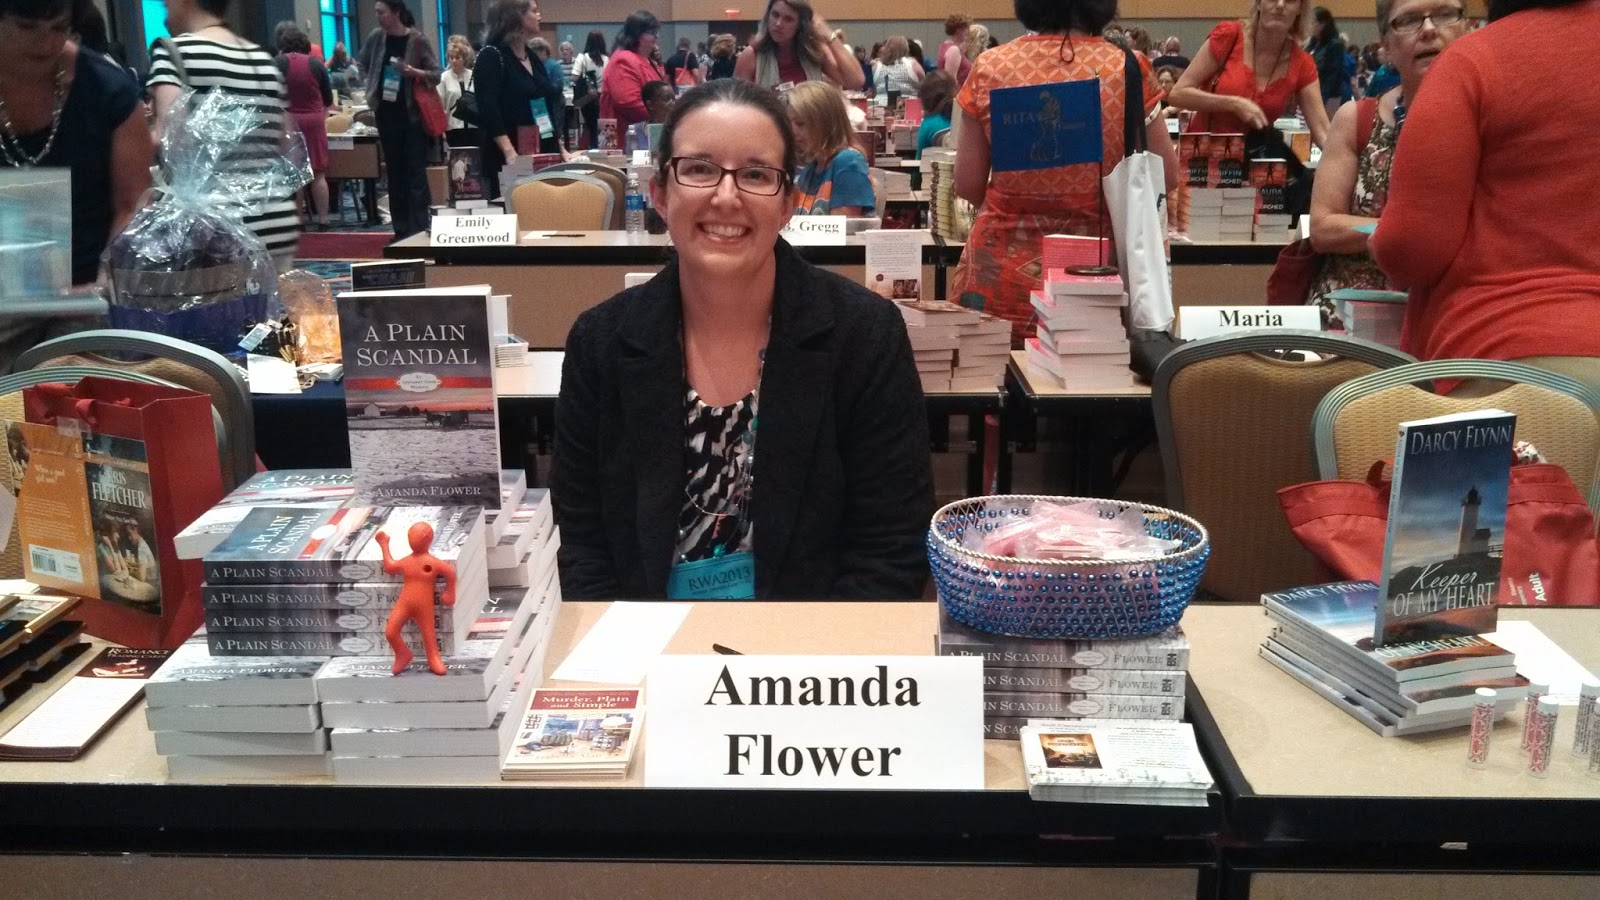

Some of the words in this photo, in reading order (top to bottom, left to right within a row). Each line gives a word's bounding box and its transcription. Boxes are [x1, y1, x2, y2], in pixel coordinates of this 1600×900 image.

[455, 216, 493, 230] Emily
[799, 220, 840, 234] Gregg
[436, 232, 510, 245] Greenwood
[1219, 309, 1284, 327] Maria
[364, 325, 381, 342] A
[386, 323, 467, 342] PLAIN
[356, 347, 477, 367] SCANDAL
[1410, 429, 1462, 455] DARCY
[1465, 424, 1512, 449] FLYNN
[245, 479, 354, 490] SCANDAL
[283, 474, 354, 482] PLAIN
[91, 481, 147, 510] FLETCHER
[375, 487, 427, 498] AMANDA
[430, 485, 481, 497] FLOWER
[252, 515, 294, 545] PLAIN
[268, 512, 321, 554] SCANDAL
[211, 568, 221, 578] A
[223, 566, 266, 578] PLAIN
[268, 566, 334, 578] SCANDAL
[688, 565, 751, 591] RWA2013
[1409, 563, 1478, 595] Keeper
[1273, 587, 1329, 603] DARCY
[1327, 582, 1379, 594] FLYNN
[1528, 572, 1547, 602] Adult
[210, 594, 219, 604] A
[221, 592, 264, 604] PLAIN
[266, 592, 331, 604] SCANDAL
[1393, 591, 1414, 617] OF
[1417, 587, 1444, 615] MY
[1446, 582, 1495, 611] HEART
[211, 617, 221, 627] A
[224, 616, 265, 628] PLAIN
[267, 616, 331, 628] SCANDAL
[215, 641, 225, 650] A
[227, 639, 268, 651] PLAIN
[270, 639, 334, 650] SCANDAL
[1430, 635, 1484, 651] HEART
[1004, 650, 1068, 663] SCANDAL
[1114, 654, 1164, 664] FLOWER
[704, 663, 921, 707] Amanda
[999, 674, 1063, 687] SCANDAL
[1109, 679, 1158, 689] FLOWER
[542, 695, 593, 703] Murder,
[573, 701, 617, 710] Simple
[999, 700, 1063, 713] SCANDAL
[1108, 703, 1158, 713] FLOWER
[723, 733, 902, 778] Flower
